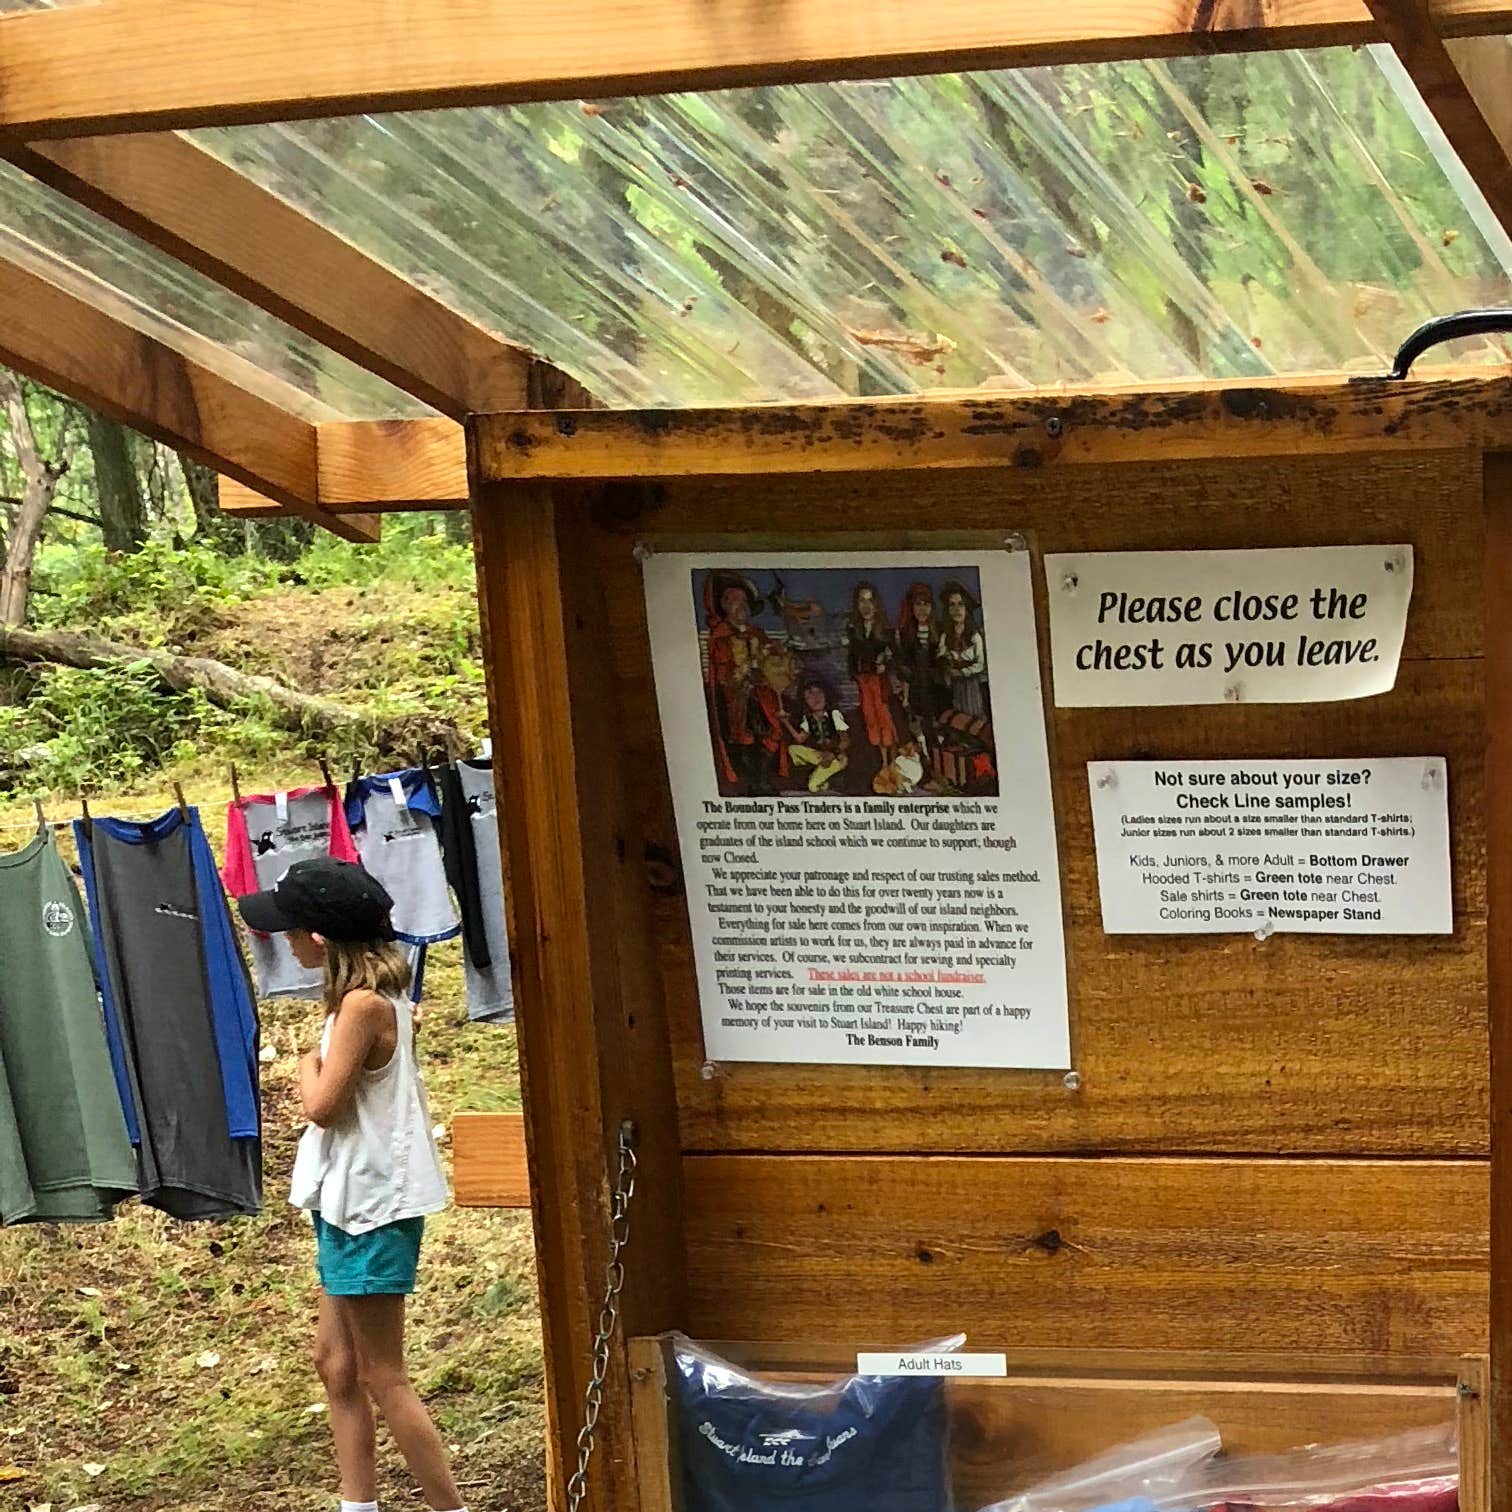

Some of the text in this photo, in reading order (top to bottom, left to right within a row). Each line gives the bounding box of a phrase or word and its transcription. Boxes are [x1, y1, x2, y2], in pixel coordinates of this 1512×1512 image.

[1097, 587, 1368, 625] Please close the
[1075, 632, 1380, 673] chest as you leave.
[1154, 768, 1372, 790] Not sure about your size?
[701, 800, 999, 817] The Boundary Pass Traders is a family enterprise which we
[1176, 792, 1352, 813] Check Line samples!
[1120, 814, 1156, 826] (Ladies
[1157, 815, 1183, 825] sizes
[1184, 816, 1202, 824] run
[1203, 814, 1233, 824] about
[1233, 815, 1241, 824] a
[1241, 814, 1262, 824] size
[1263, 814, 1299, 824] smaller
[1300, 814, 1323, 824] than
[1324, 813, 1369, 824] standard
[1129, 854, 1159, 868] Kids,
[1162, 855, 1212, 868] Juniors,
[1214, 854, 1225, 867] &
[1227, 856, 1260, 866] more
[1263, 853, 1295, 866] Adult
[1309, 853, 1358, 867] Bottom
[1361, 854, 1410, 867] Drawer
[1142, 872, 1190, 885] Hooded
[1192, 871, 1241, 884] T-shirts
[1255, 871, 1295, 884] Green
[1297, 872, 1323, 885] tote
[1325, 875, 1354, 885] near
[1357, 872, 1398, 886] Chest.
[1159, 889, 1188, 902] Sale
[1190, 889, 1225, 902] shirts
[1239, 887, 1280, 901] Green
[1282, 889, 1308, 902] tote
[1310, 892, 1338, 903] near
[1159, 907, 1211, 922] Coloring
[1214, 906, 1253, 919] Books
[1267, 906, 1340, 923] Newspaper
[845, 1033, 940, 1050] The Benson Family
[897, 1357, 963, 1371] Adult Hats
